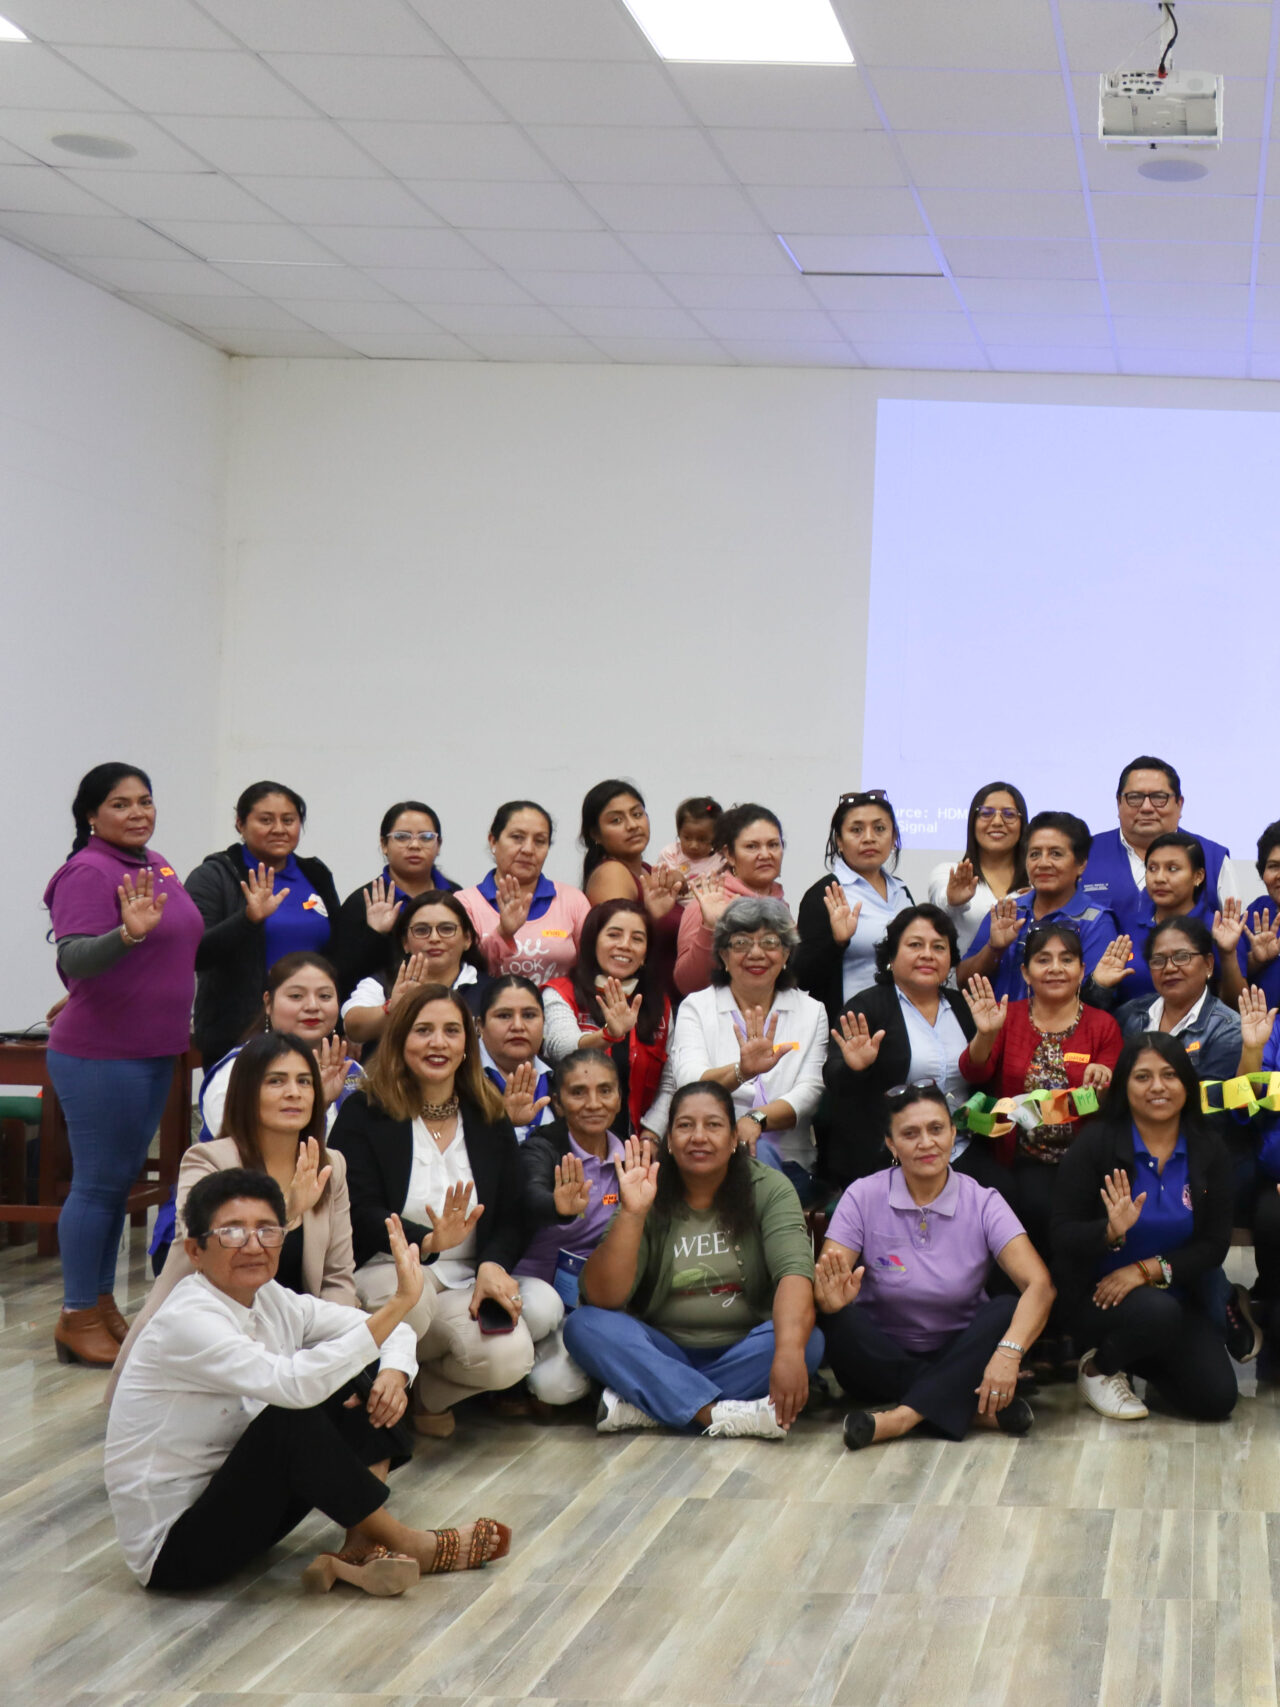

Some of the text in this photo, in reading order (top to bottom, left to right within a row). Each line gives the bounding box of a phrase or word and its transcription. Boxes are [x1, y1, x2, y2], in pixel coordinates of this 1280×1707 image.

[898, 820, 938, 834] Signal
[500, 959, 545, 977] LOOK
[673, 1231, 730, 1259] WEE
